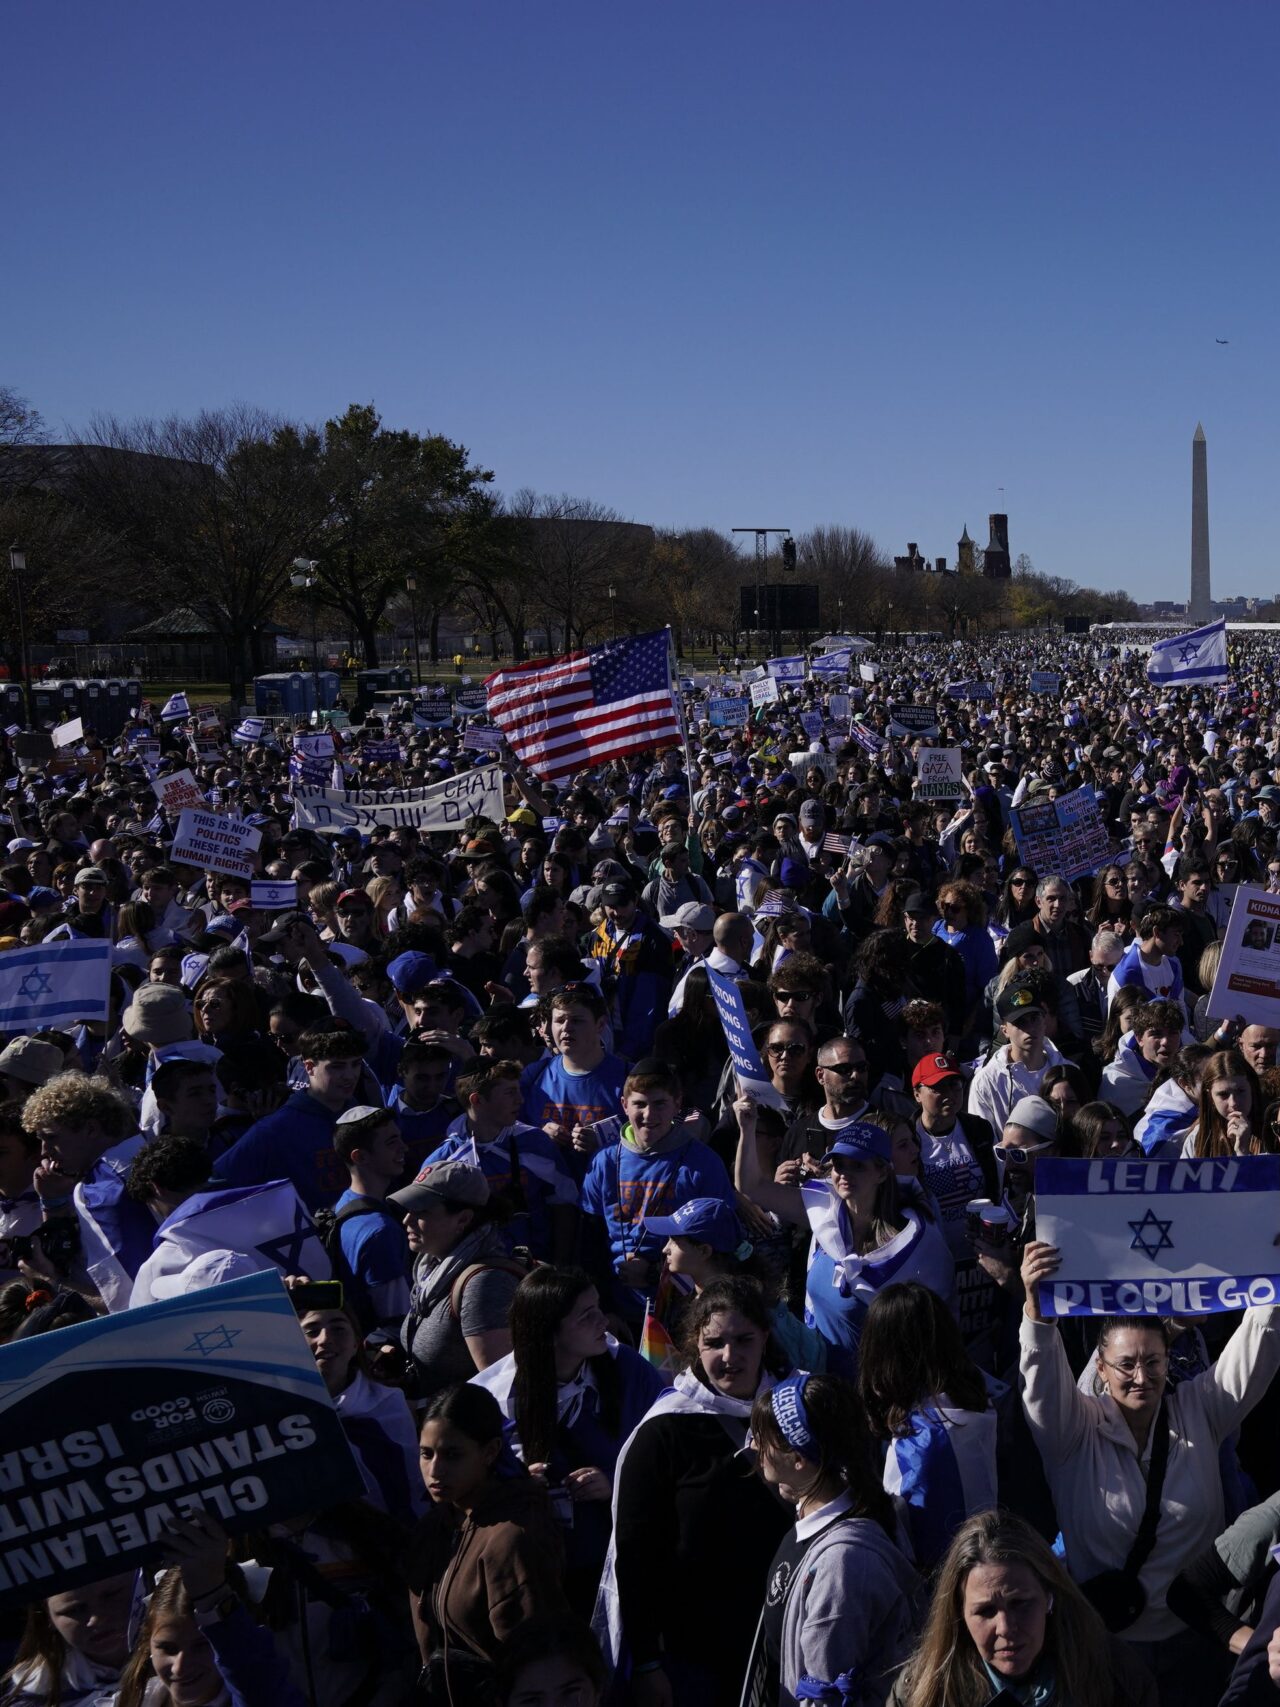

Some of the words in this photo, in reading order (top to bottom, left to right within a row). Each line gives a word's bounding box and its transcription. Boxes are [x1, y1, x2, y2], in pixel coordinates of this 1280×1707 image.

[922, 762, 954, 774] GAZA
[929, 754, 948, 762] FREE
[163, 778, 186, 792] FREE
[444, 768, 499, 798] CHAI
[921, 782, 960, 796] HAMAS
[341, 803, 427, 829] ישראל
[441, 798, 484, 823] עם
[193, 813, 215, 827] THIS
[218, 819, 228, 831] IS
[231, 822, 252, 837] NOT
[196, 827, 241, 846] POLITICS
[175, 848, 211, 864] HUMAN
[214, 857, 250, 873] RIGHTS
[189, 838, 220, 854] THESE
[222, 848, 243, 859] ARE
[1087, 1160, 1170, 1193] LET
[1170, 1160, 1241, 1193] MY
[1053, 1280, 1214, 1316] PEOPLE
[1217, 1277, 1276, 1309] GO
[130, 1396, 191, 1423] GOOD
[155, 1410, 198, 1429] FOR
[778, 1386, 811, 1447] CLEVELAND
[104, 1413, 318, 1504] STANDS
